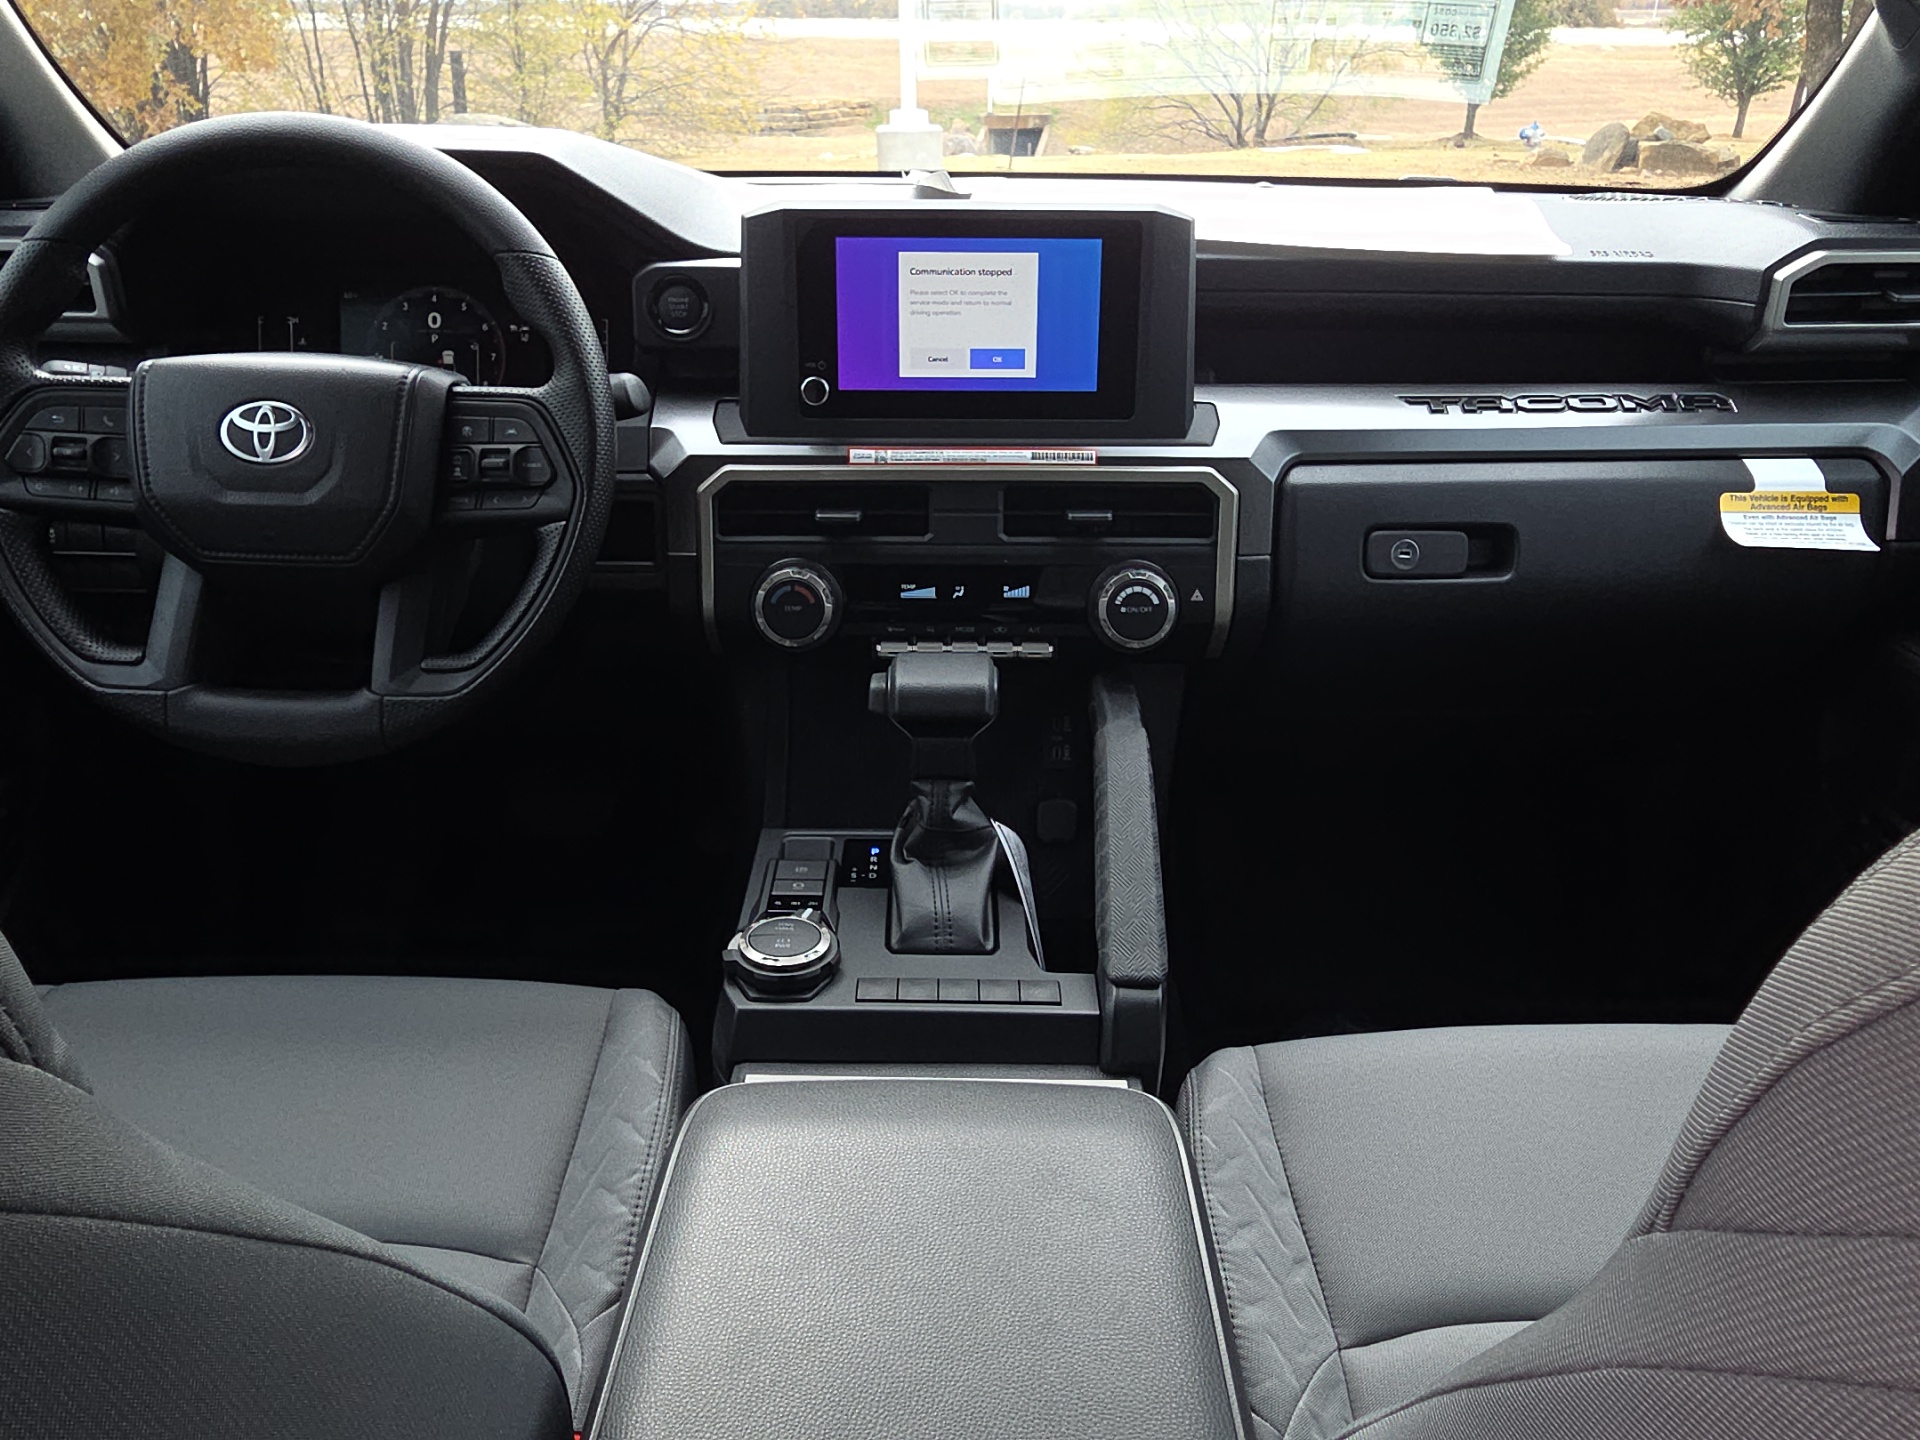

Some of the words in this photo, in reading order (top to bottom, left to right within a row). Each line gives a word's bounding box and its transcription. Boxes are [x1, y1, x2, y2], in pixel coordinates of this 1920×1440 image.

[909, 267, 976, 276] Communication
[978, 267, 1013, 278] stopped
[427, 312, 442, 329] 0
[431, 333, 438, 344] P
[1395, 393, 1739, 415] TACOMA
[1729, 494, 1747, 502] This
[1749, 494, 1778, 502] Vehicle
[1780, 494, 1788, 502] is
[1790, 495, 1829, 504] Equipped
[1750, 503, 1790, 511] Advanced
[1793, 503, 1804, 511] Air
[1807, 503, 1828, 512] Bags
[870, 847, 880, 855] P
